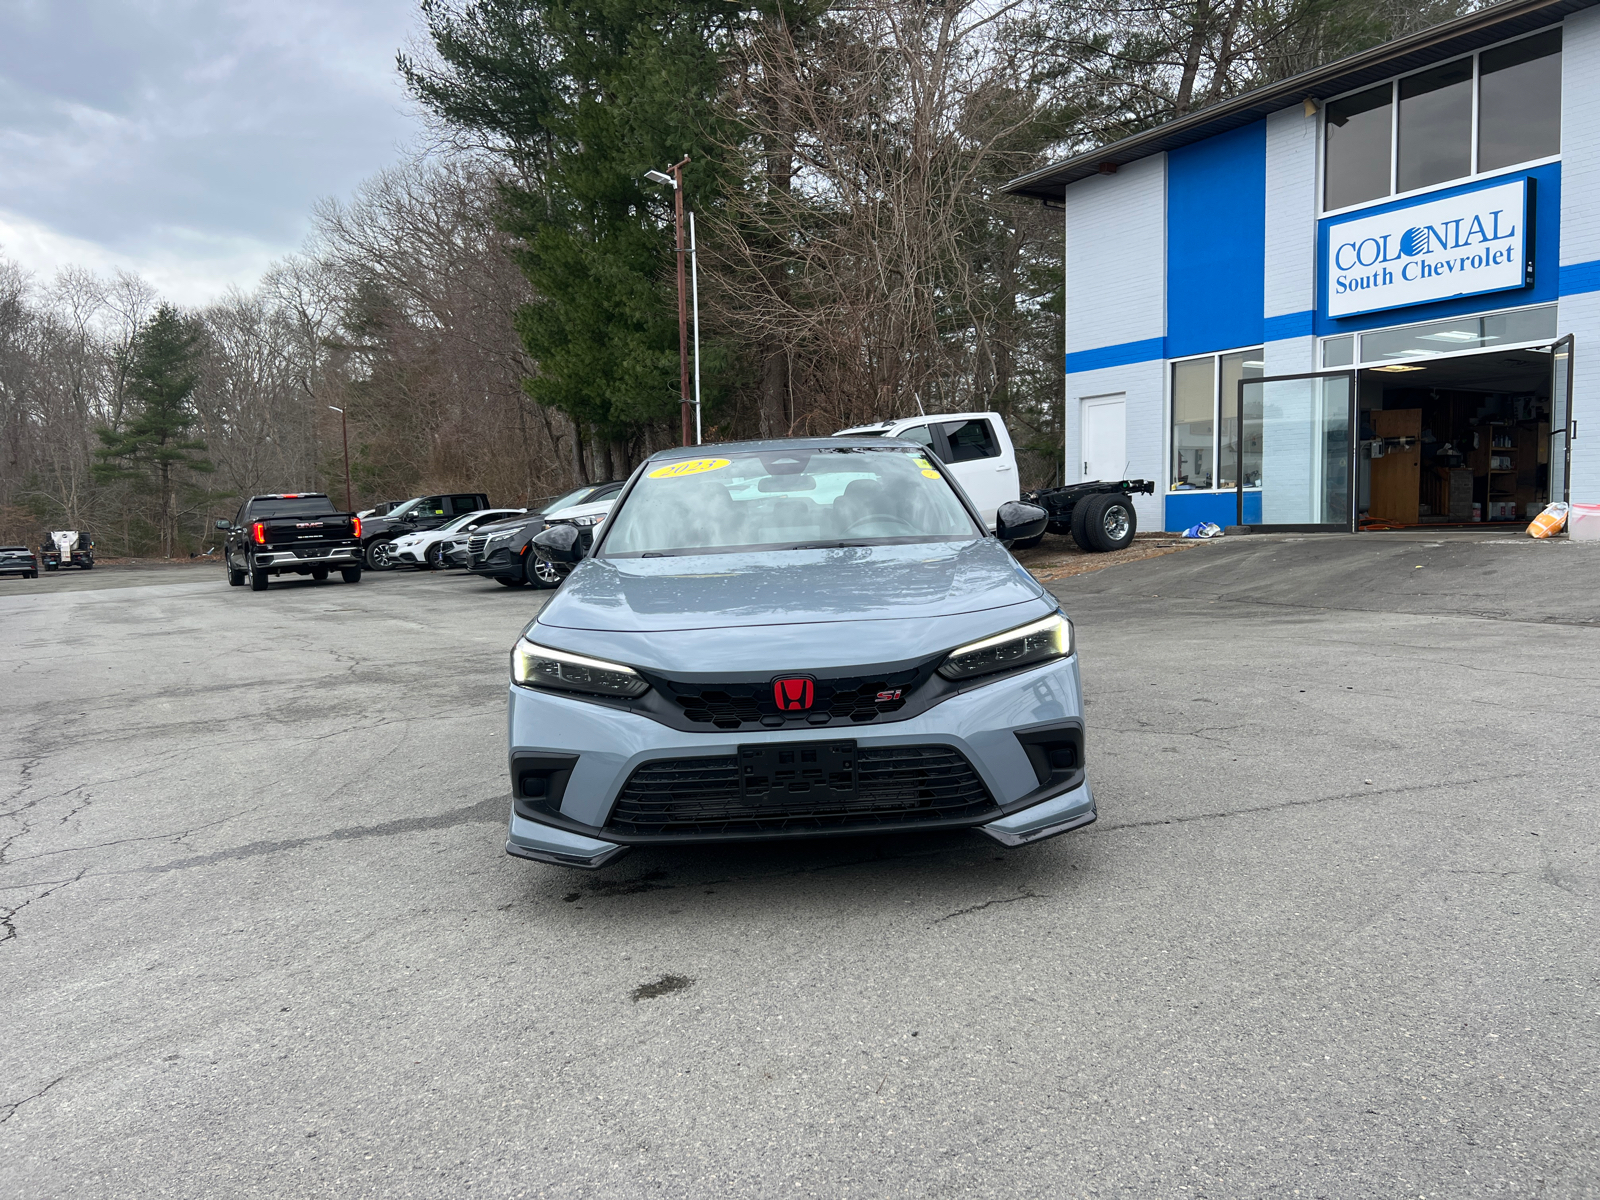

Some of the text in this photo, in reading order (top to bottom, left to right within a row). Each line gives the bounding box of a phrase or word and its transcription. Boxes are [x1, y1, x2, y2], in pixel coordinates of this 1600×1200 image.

[1335, 209, 1516, 271] COLONIAL
[1335, 243, 1515, 295] South Chevrolet
[659, 460, 717, 477] 2023
[296, 521, 324, 529] GMC
